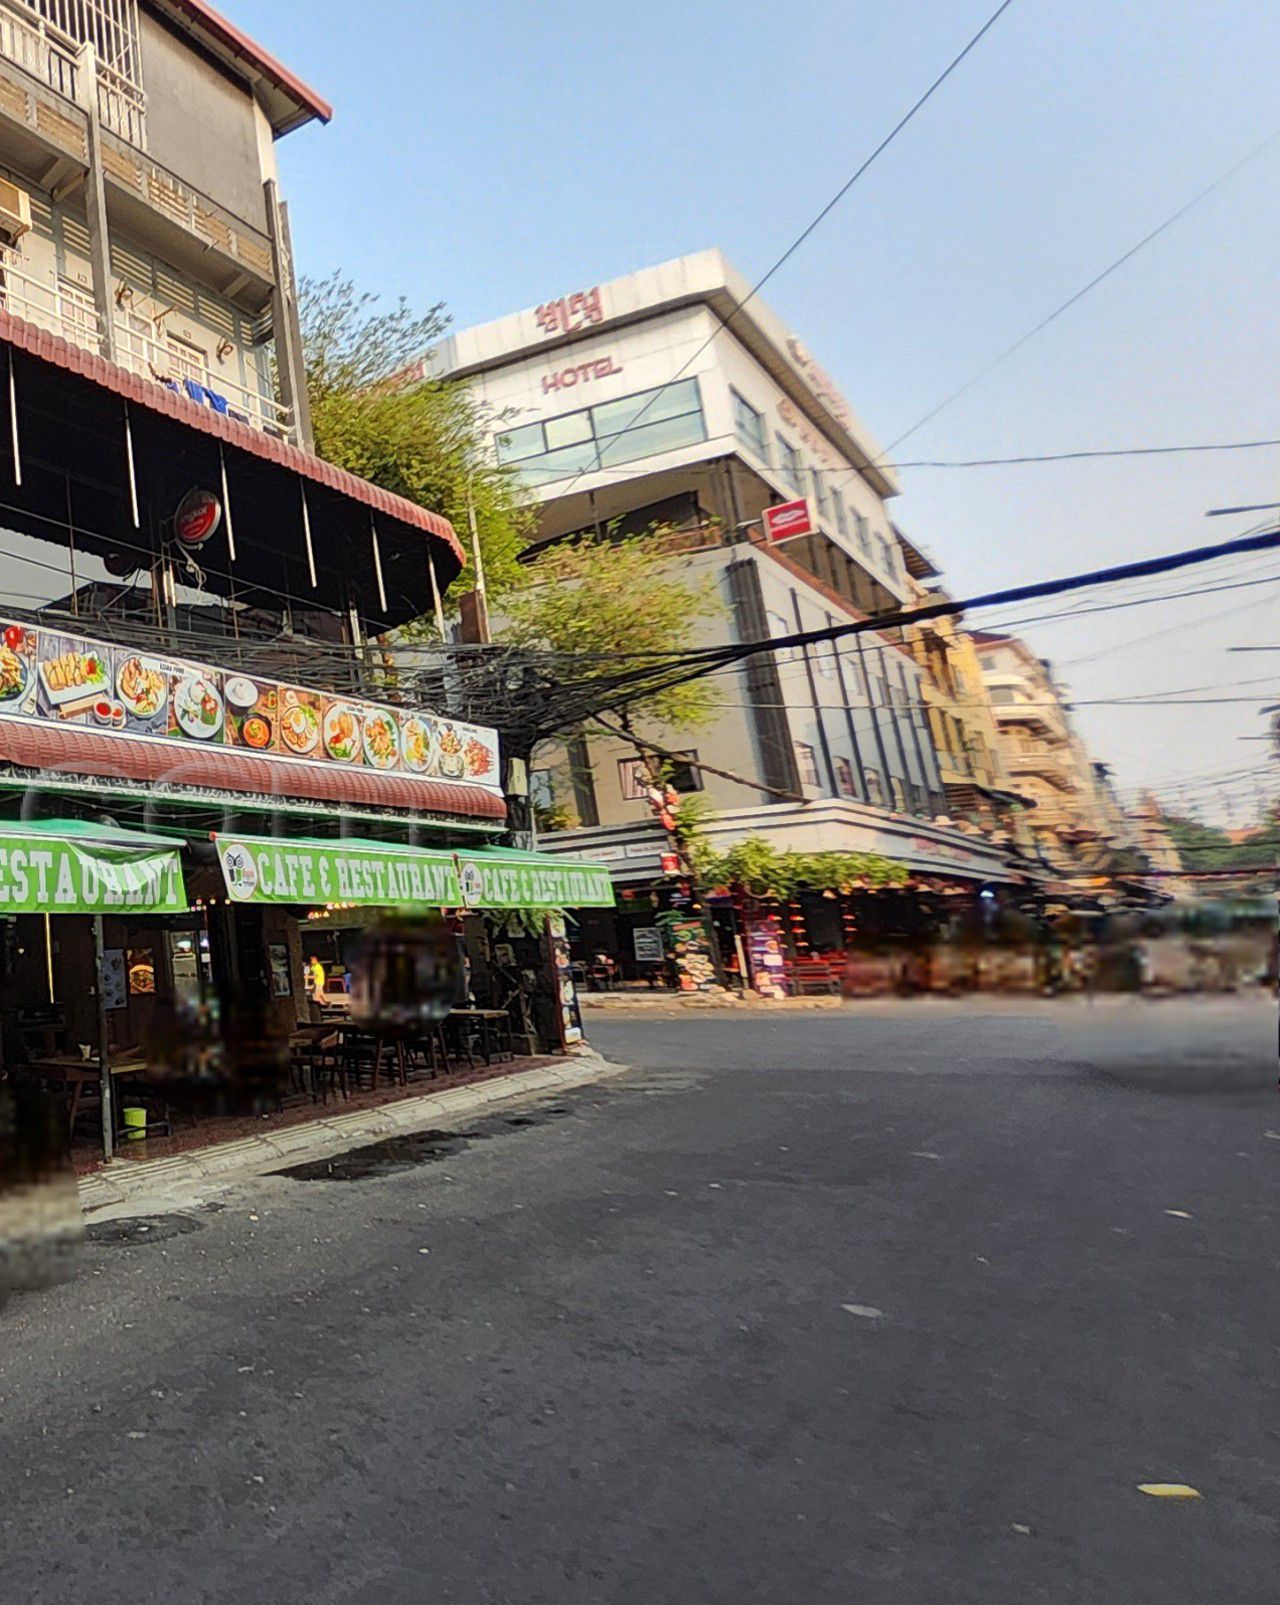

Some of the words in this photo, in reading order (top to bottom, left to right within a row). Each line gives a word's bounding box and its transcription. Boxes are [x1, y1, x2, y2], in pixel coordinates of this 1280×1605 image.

[541, 356, 623, 395] HOTEL
[257, 852, 316, 897] CAFE
[318, 856, 331, 897] &
[335, 858, 455, 901] RESTAURANT
[483, 868, 520, 902] CAFE
[520, 870, 531, 902] &
